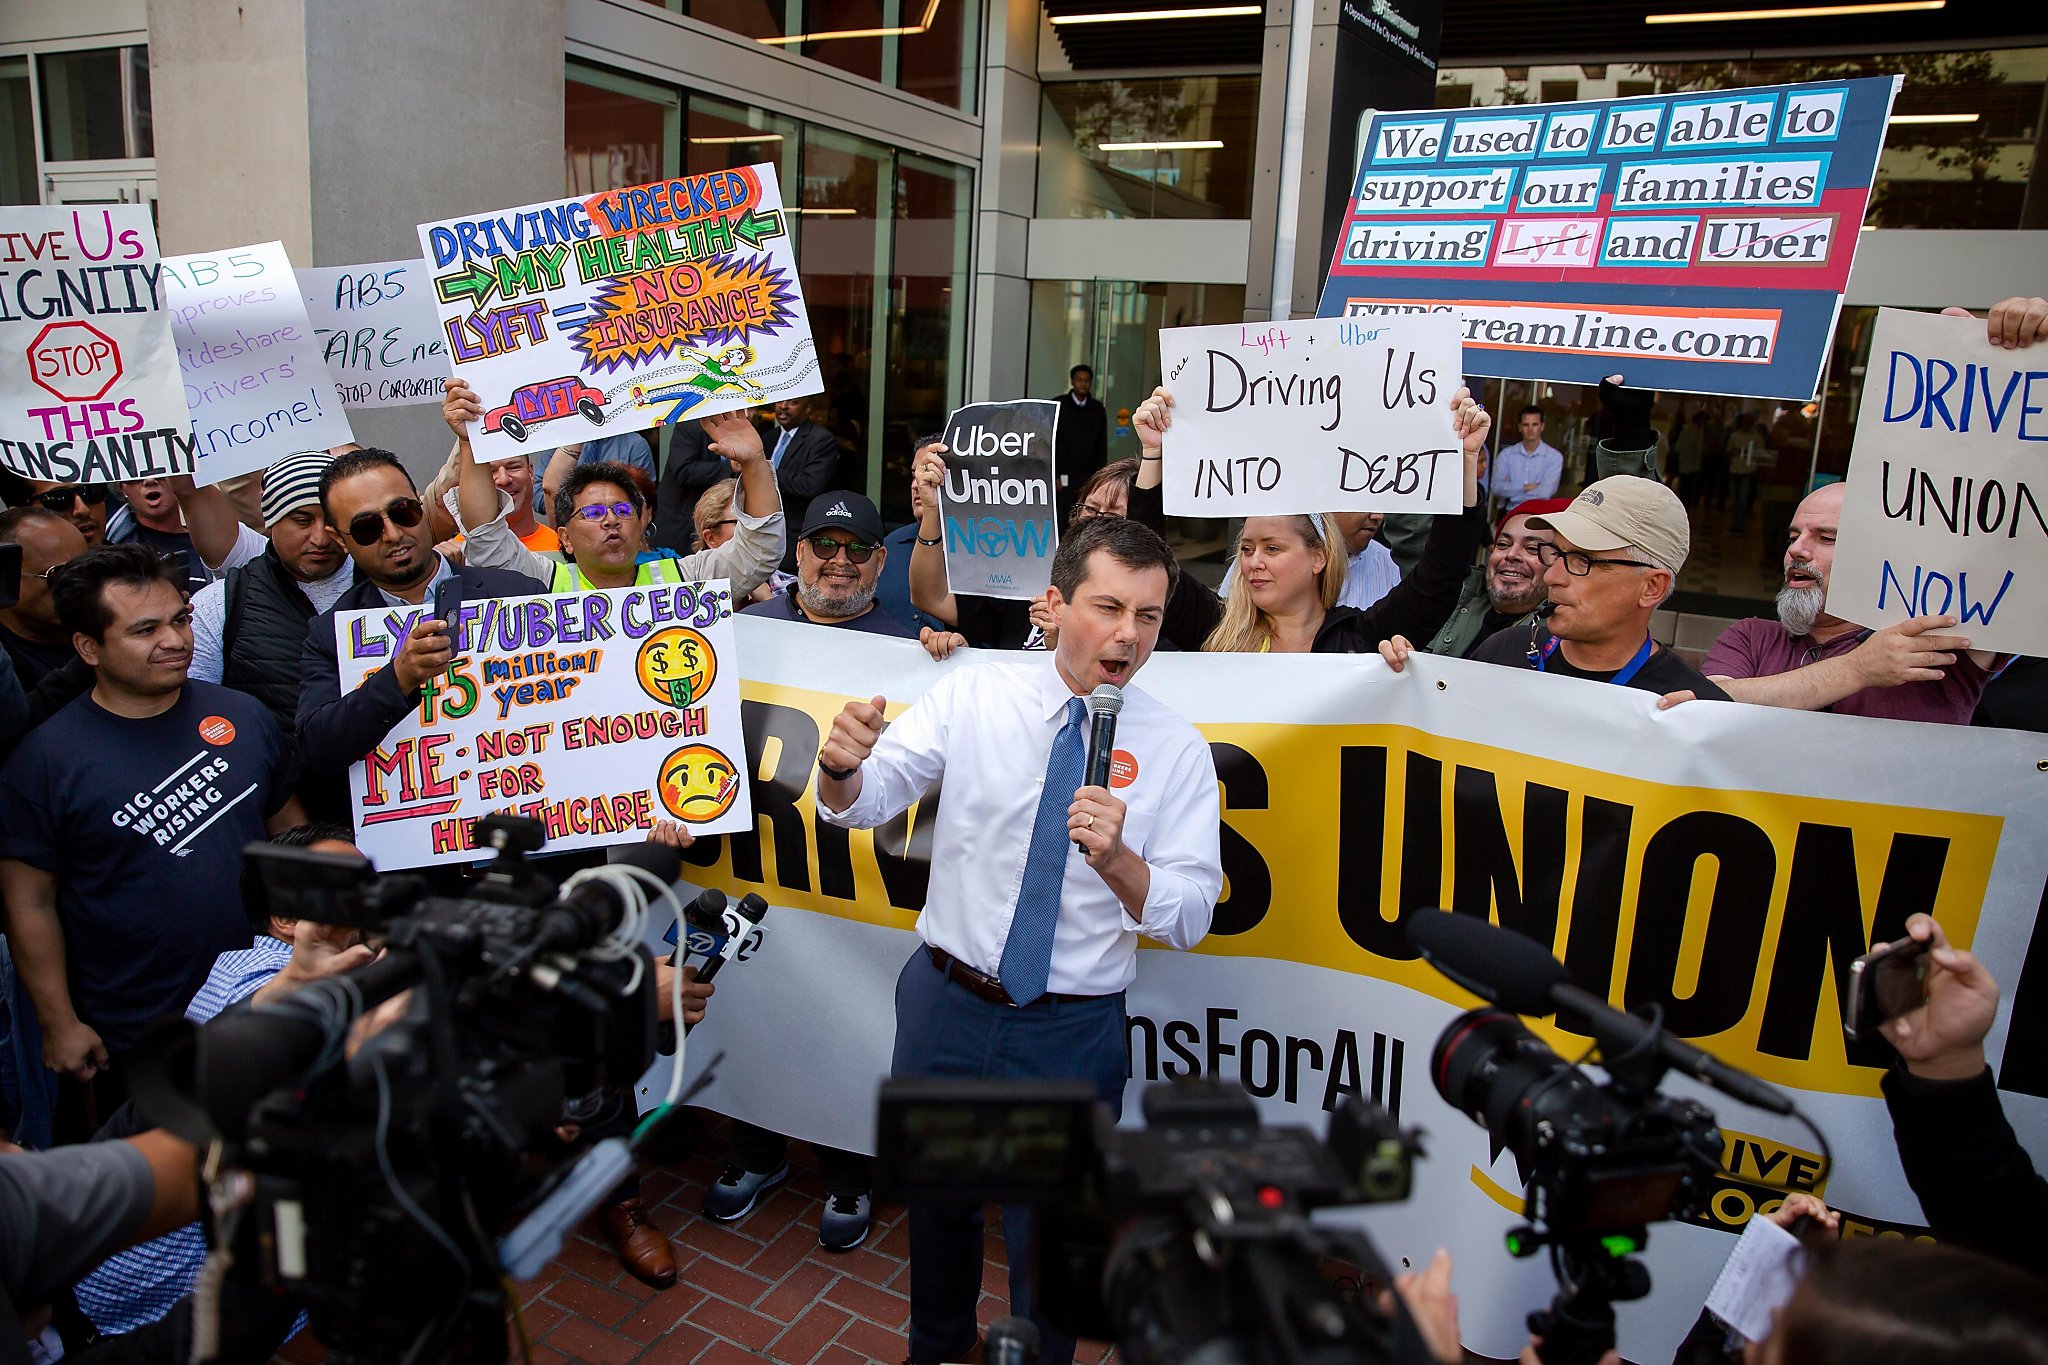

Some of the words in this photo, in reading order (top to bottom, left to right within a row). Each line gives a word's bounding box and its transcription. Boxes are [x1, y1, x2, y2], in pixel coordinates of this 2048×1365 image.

[1381, 128, 1438, 158] We
[1451, 121, 1538, 154] used
[1549, 122, 1589, 150] to
[1608, 113, 1656, 146] be
[1670, 103, 1769, 142] able
[1786, 103, 1834, 135] to
[1360, 173, 1506, 208] support
[1523, 176, 1598, 205] our
[1619, 165, 1816, 203] families
[0, 230, 70, 262] IVE
[73, 210, 144, 262] Us
[428, 202, 592, 269] DRIVING
[599, 171, 749, 232] WRECKED
[1347, 226, 1488, 263] driving
[1502, 221, 1593, 265] Lyft
[1606, 225, 1691, 261] and
[1707, 221, 1828, 260] Uber
[161, 254, 265, 288] AB5
[493, 244, 571, 299] MY
[577, 215, 735, 285] HEALTH
[336, 268, 407, 311] AB5
[631, 263, 703, 309] NO
[445, 298, 549, 366] LYFT
[591, 284, 766, 352] INSURANCE
[1241, 326, 1292, 356] Lyft
[1308, 335, 1316, 345] +
[1340, 322, 1390, 347] Uber
[37, 341, 110, 377] STOP
[412, 340, 449, 363] ne
[1170, 355, 1189, 381] are
[335, 382, 372, 405] STOP
[379, 376, 448, 401] CORPORATE
[513, 381, 579, 421] LYFT
[1205, 348, 1343, 432] Driving
[1382, 348, 1437, 410] Us
[1882, 350, 2048, 442] DRIVE
[27, 398, 145, 442] THIS
[191, 388, 323, 459] Income!
[952, 425, 1035, 457] Uber
[0, 428, 196, 483] INSANITY
[1194, 456, 1282, 499] INTO
[1337, 446, 1459, 501] DEBT
[944, 466, 1048, 505] Union
[1881, 460, 2048, 539] UNION
[825, 509, 852, 518] adidas
[1877, 559, 2015, 626] NOW
[350, 592, 616, 662] LYT/UBER
[493, 675, 581, 719] year
[360, 732, 473, 808] ME:
[476, 721, 554, 765] NOT
[562, 707, 709, 751] ENOUGH
[478, 761, 545, 800] FOR
[112, 792, 153, 827] GIG
[131, 756, 229, 835] WORKERS
[152, 786, 223, 846] RISING
[1338, 744, 1951, 1070] UNION
[1720, 1138, 1821, 1193] IVE
